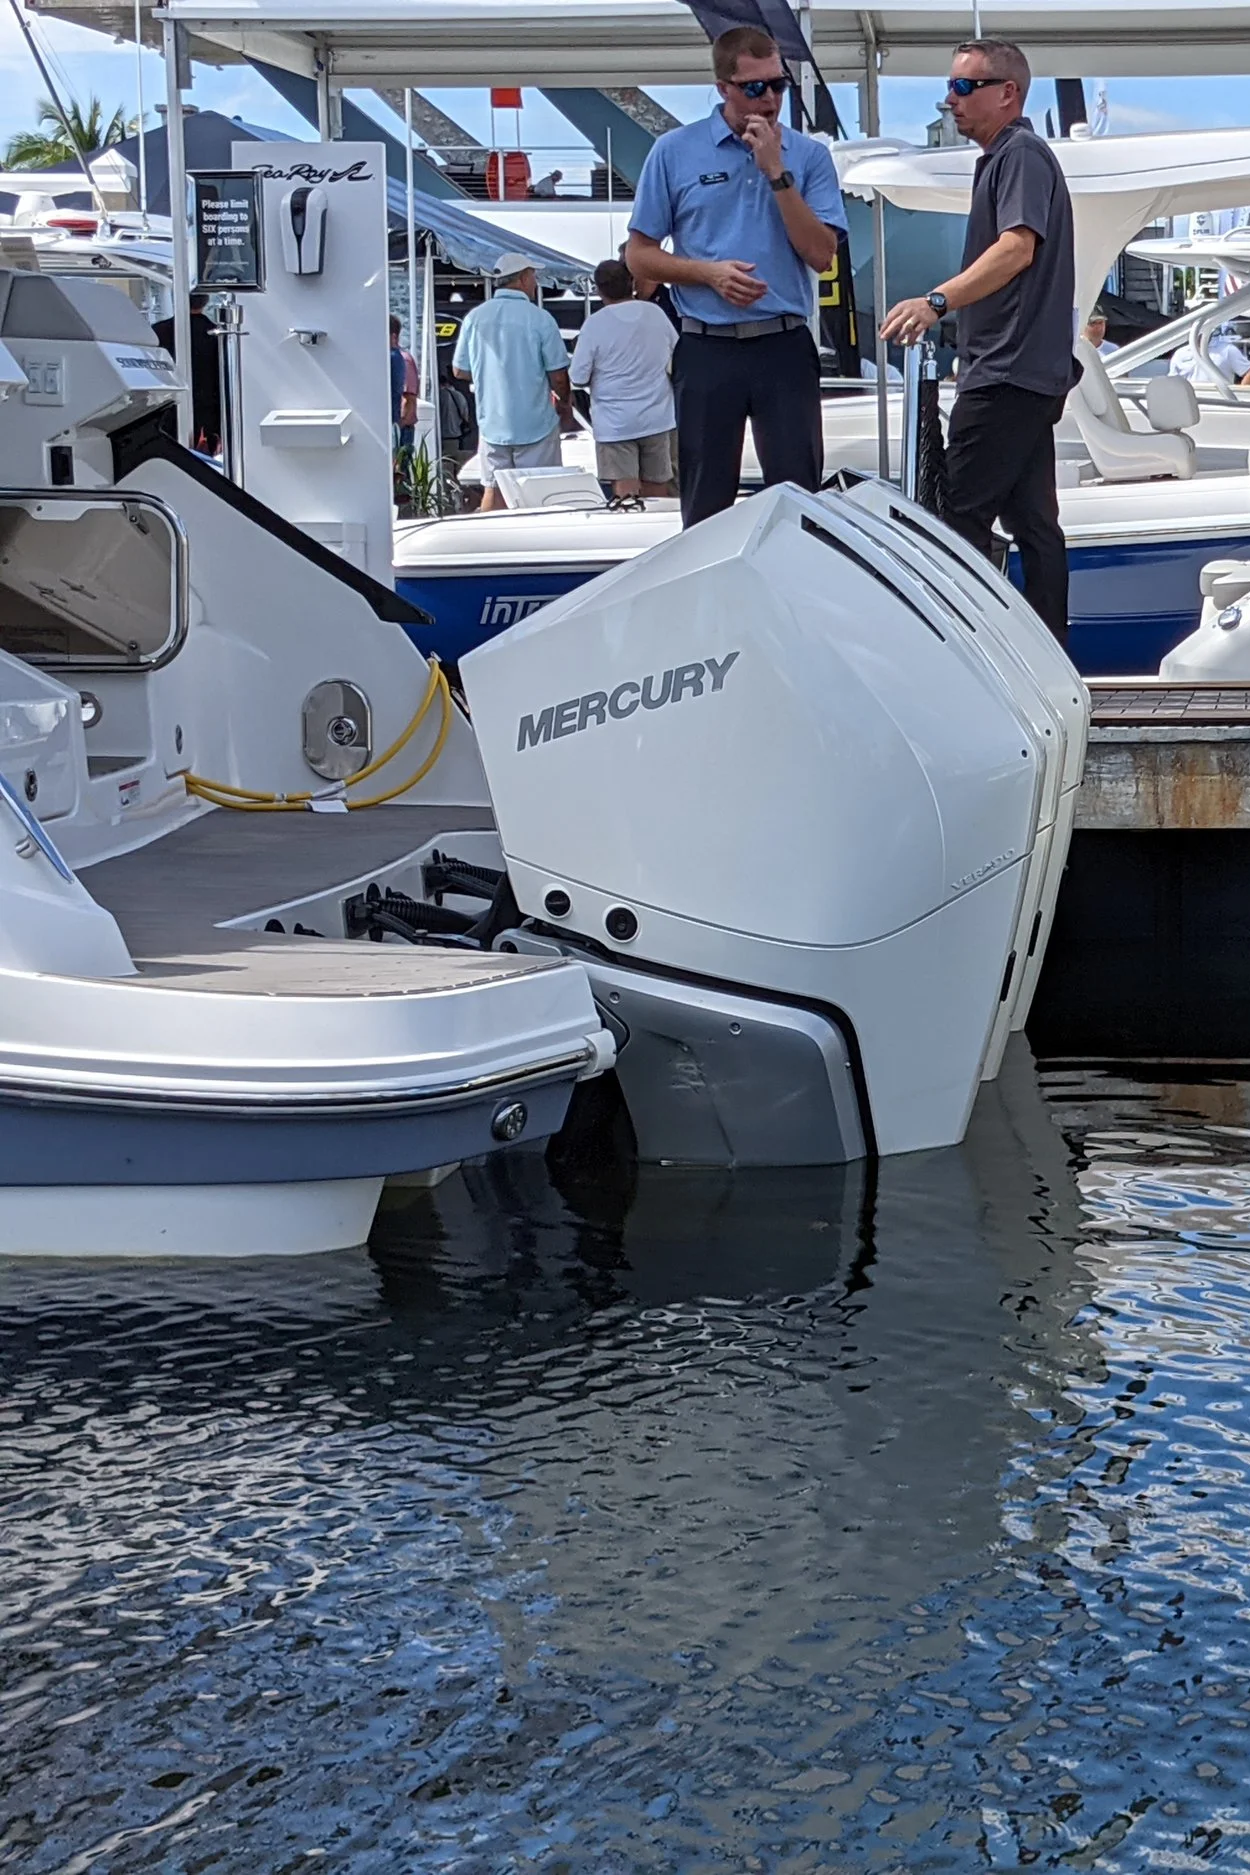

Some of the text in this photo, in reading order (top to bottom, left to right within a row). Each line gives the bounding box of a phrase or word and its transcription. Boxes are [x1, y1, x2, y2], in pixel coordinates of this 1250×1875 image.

[287, 163, 332, 184] Ray
[201, 199, 249, 209] Please limit
[203, 212, 249, 223] boarding to
[202, 224, 250, 235] SIX persons
[207, 237, 245, 246] at a time.
[517, 651, 741, 752] MERCURY
